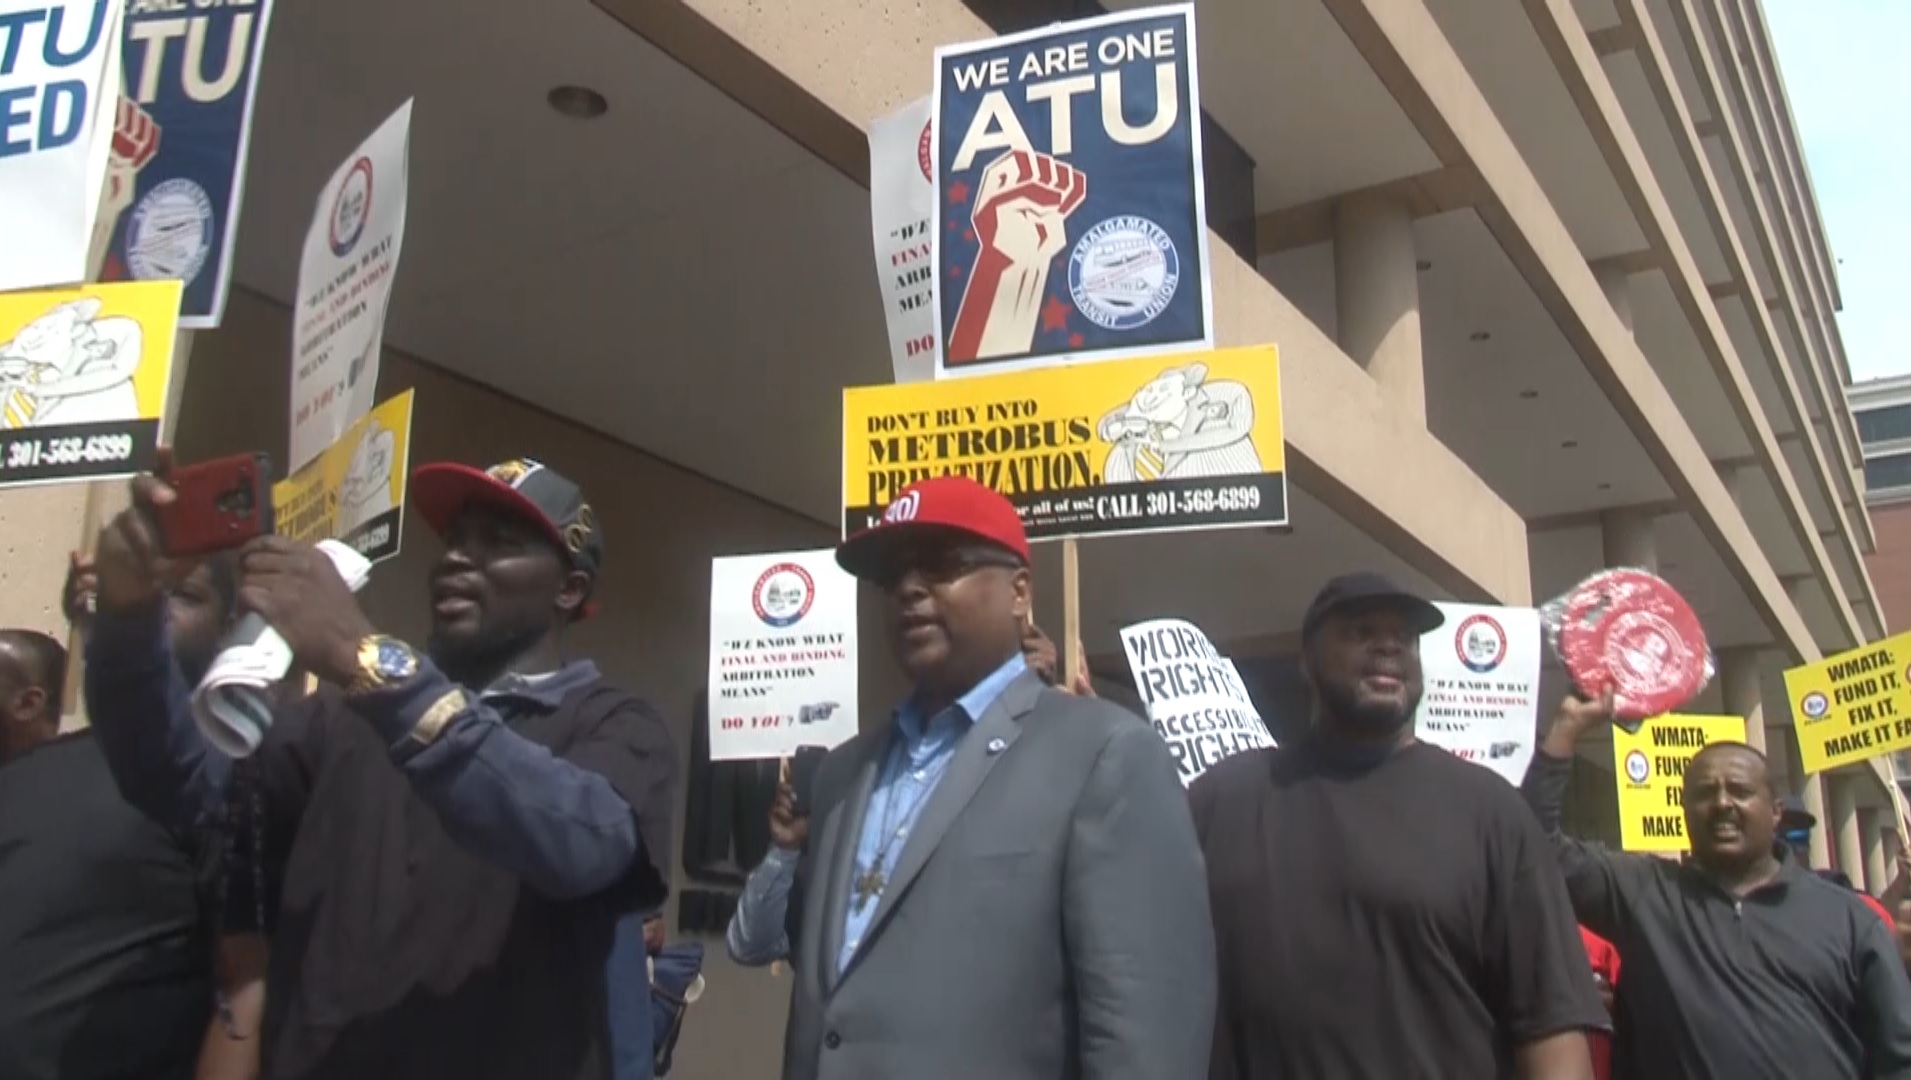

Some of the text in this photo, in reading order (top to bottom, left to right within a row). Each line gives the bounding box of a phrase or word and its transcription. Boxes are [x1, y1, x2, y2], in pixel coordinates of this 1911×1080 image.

[0, 0, 109, 75] TU
[129, 13, 253, 103] TU
[953, 28, 1175, 92] WE ARE ONE
[0, 79, 87, 157] ED
[951, 62, 1178, 172] ATU
[1073, 217, 1170, 263] AMALGAMATED
[891, 242, 932, 266] FINA
[895, 266, 932, 290] ARB
[899, 289, 933, 311] MEA
[1143, 273, 1177, 319] UNION
[906, 334, 934, 358] DO
[867, 398, 1038, 433] DON'T BUY INTO
[867, 417, 1092, 466] METROBUS
[867, 449, 1100, 507] PRIIZATION.
[1032, 500, 1052, 516] all
[1054, 498, 1071, 513] of
[1096, 485, 1261, 520] CALL 301-568-6899
[757, 636, 797, 650] KNOW
[803, 633, 844, 646] WHAT
[721, 648, 846, 666] FINAL AND BINDING
[1827, 649, 1895, 683] WMATA:
[720, 666, 815, 683] ARBITRATION
[1458, 680, 1492, 691] KNOW
[1496, 682, 1528, 693] WHAT
[1463, 694, 1484, 704] AND
[1834, 678, 1878, 705] FUND
[721, 717, 744, 731] DO
[1427, 706, 1505, 719] ARBITRATION
[1848, 704, 1876, 727] FIX
[1824, 717, 1911, 758] MAKE IT FA
[1642, 815, 1683, 838] MAKE
